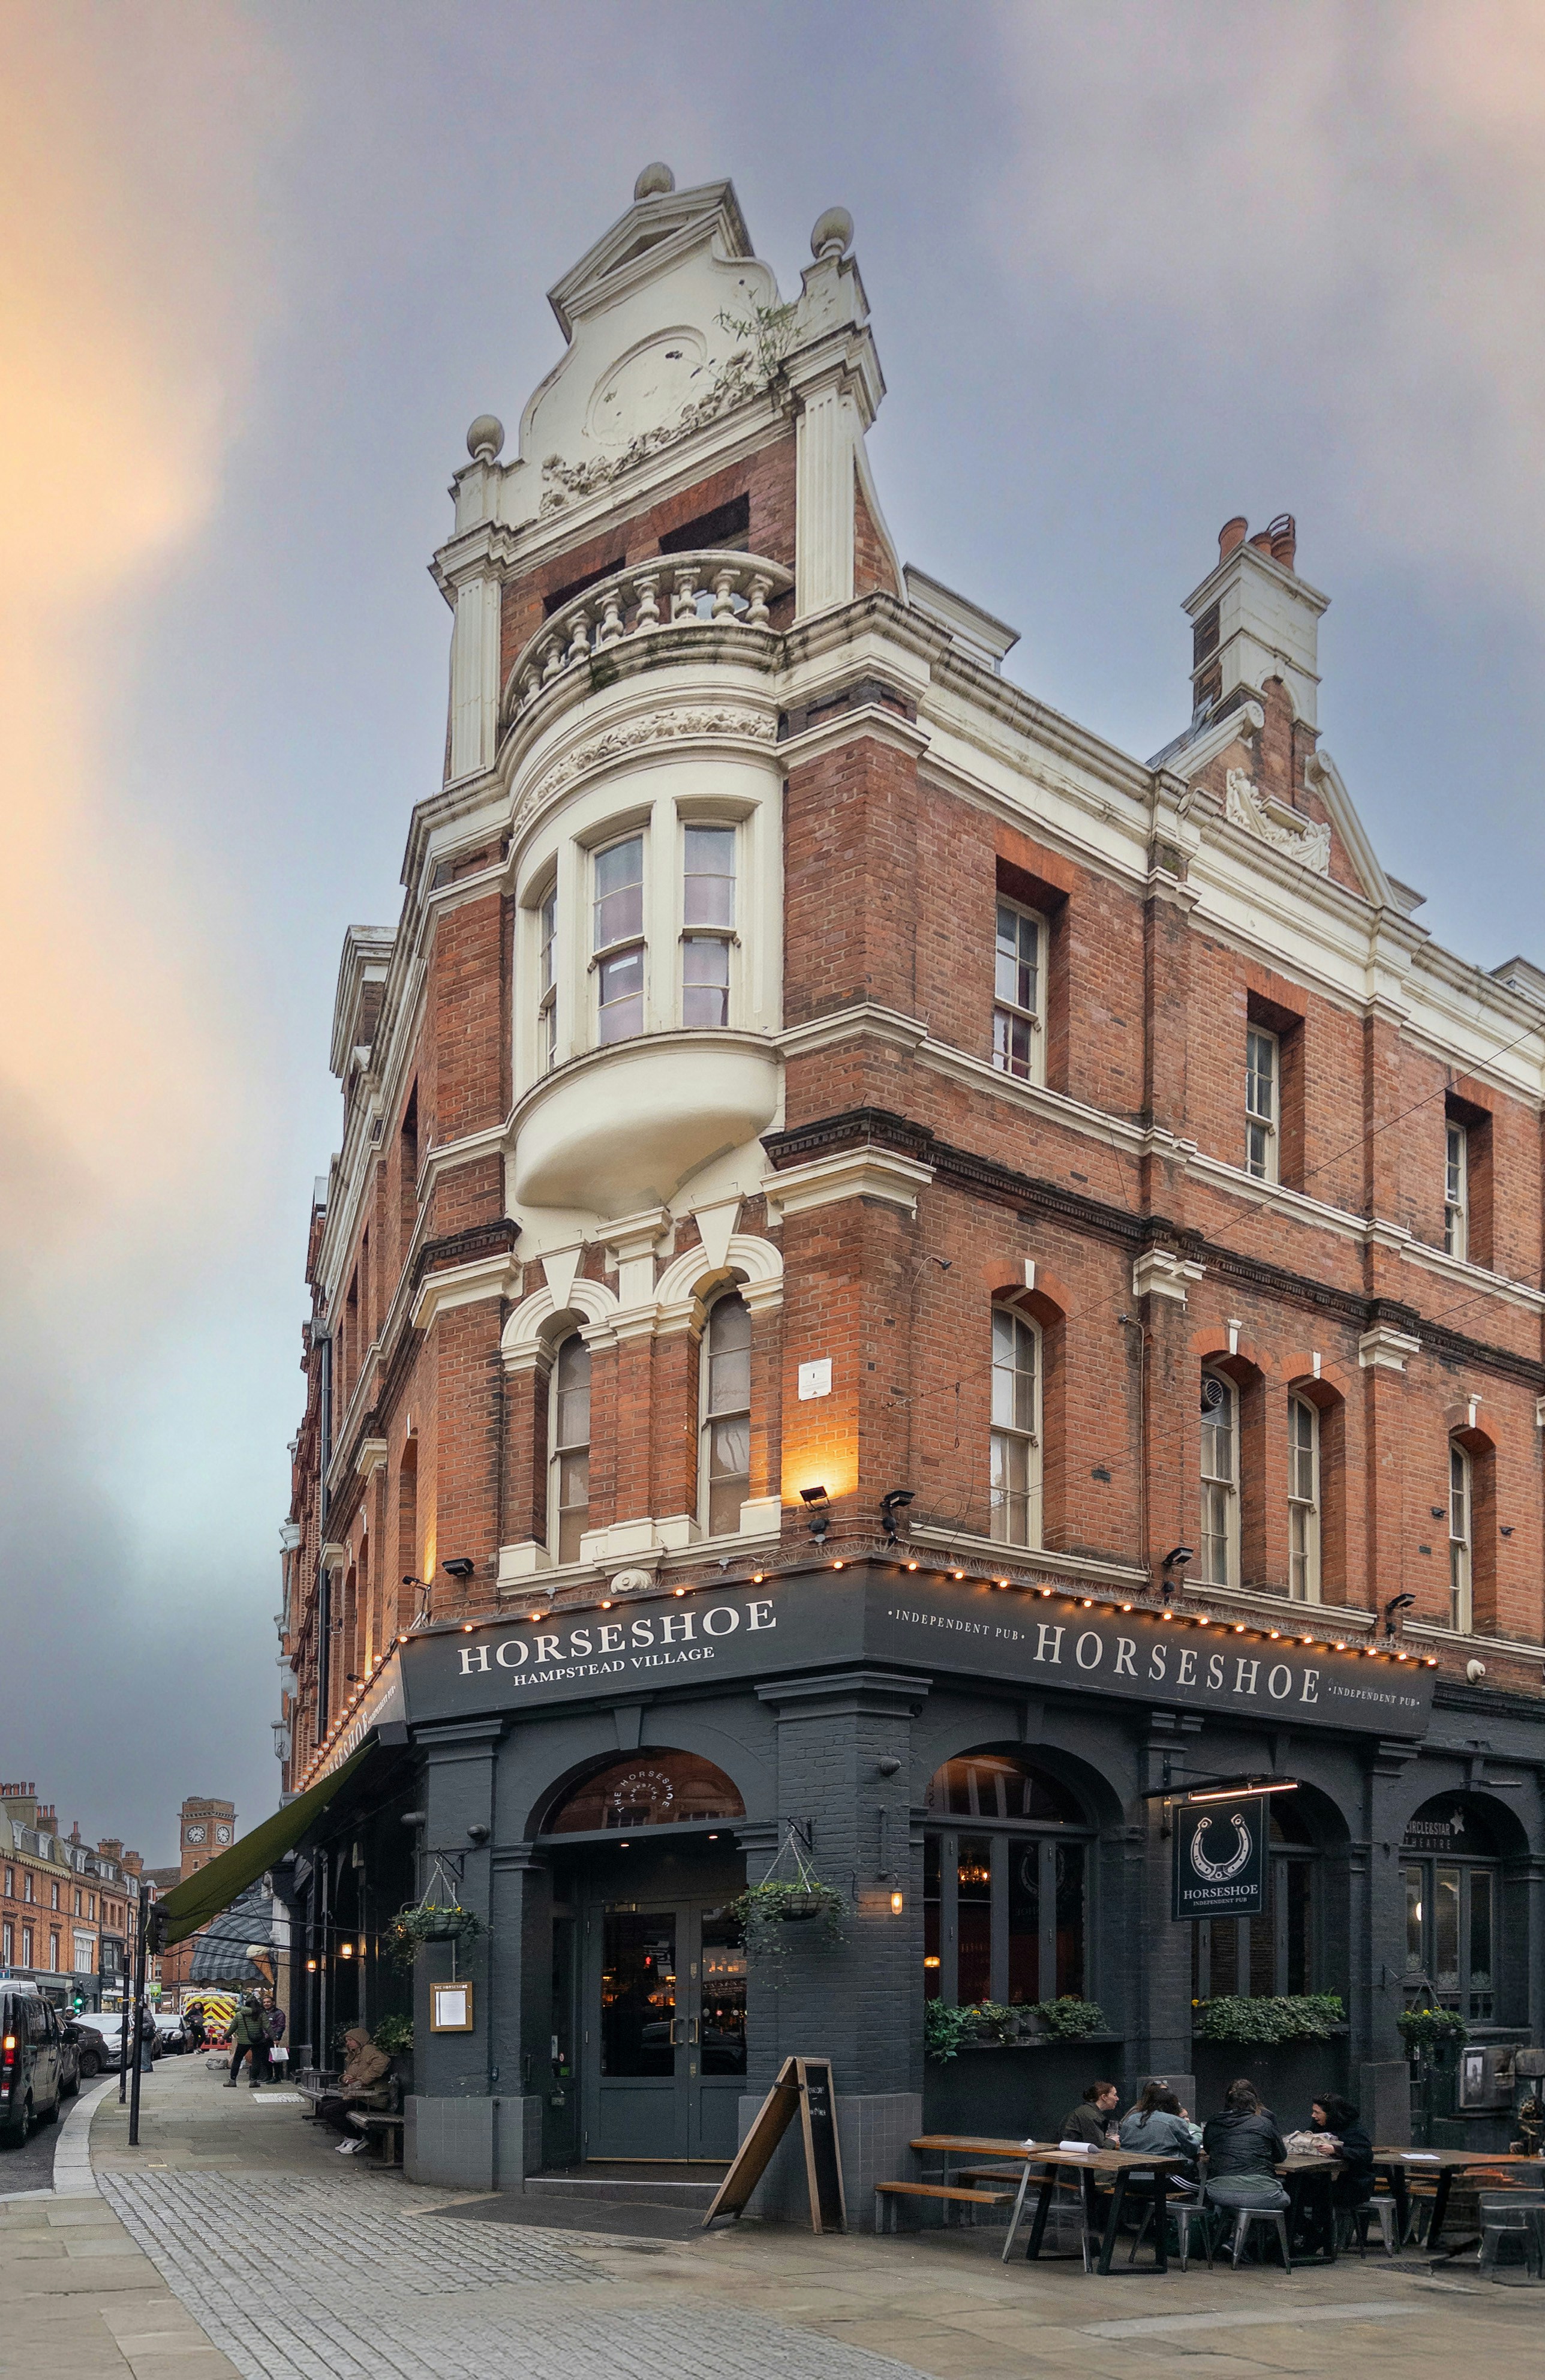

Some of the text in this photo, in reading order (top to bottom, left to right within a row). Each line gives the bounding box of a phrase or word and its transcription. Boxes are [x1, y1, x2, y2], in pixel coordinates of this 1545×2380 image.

[458, 1599, 777, 1675] HORSESHOE
[895, 1610, 1018, 1640] INDEPENDENT PUB
[513, 1646, 715, 1686] HAMPSTEAD VILLAGE
[1033, 1623, 1319, 1703] HORSESHOE
[1333, 1686, 1416, 1707] INDEPENDENT PUB
[614, 1791, 625, 1812] THE
[630, 1783, 658, 1803] HAMPSTEAD
[1183, 1884, 1258, 1899] HORSESHOE
